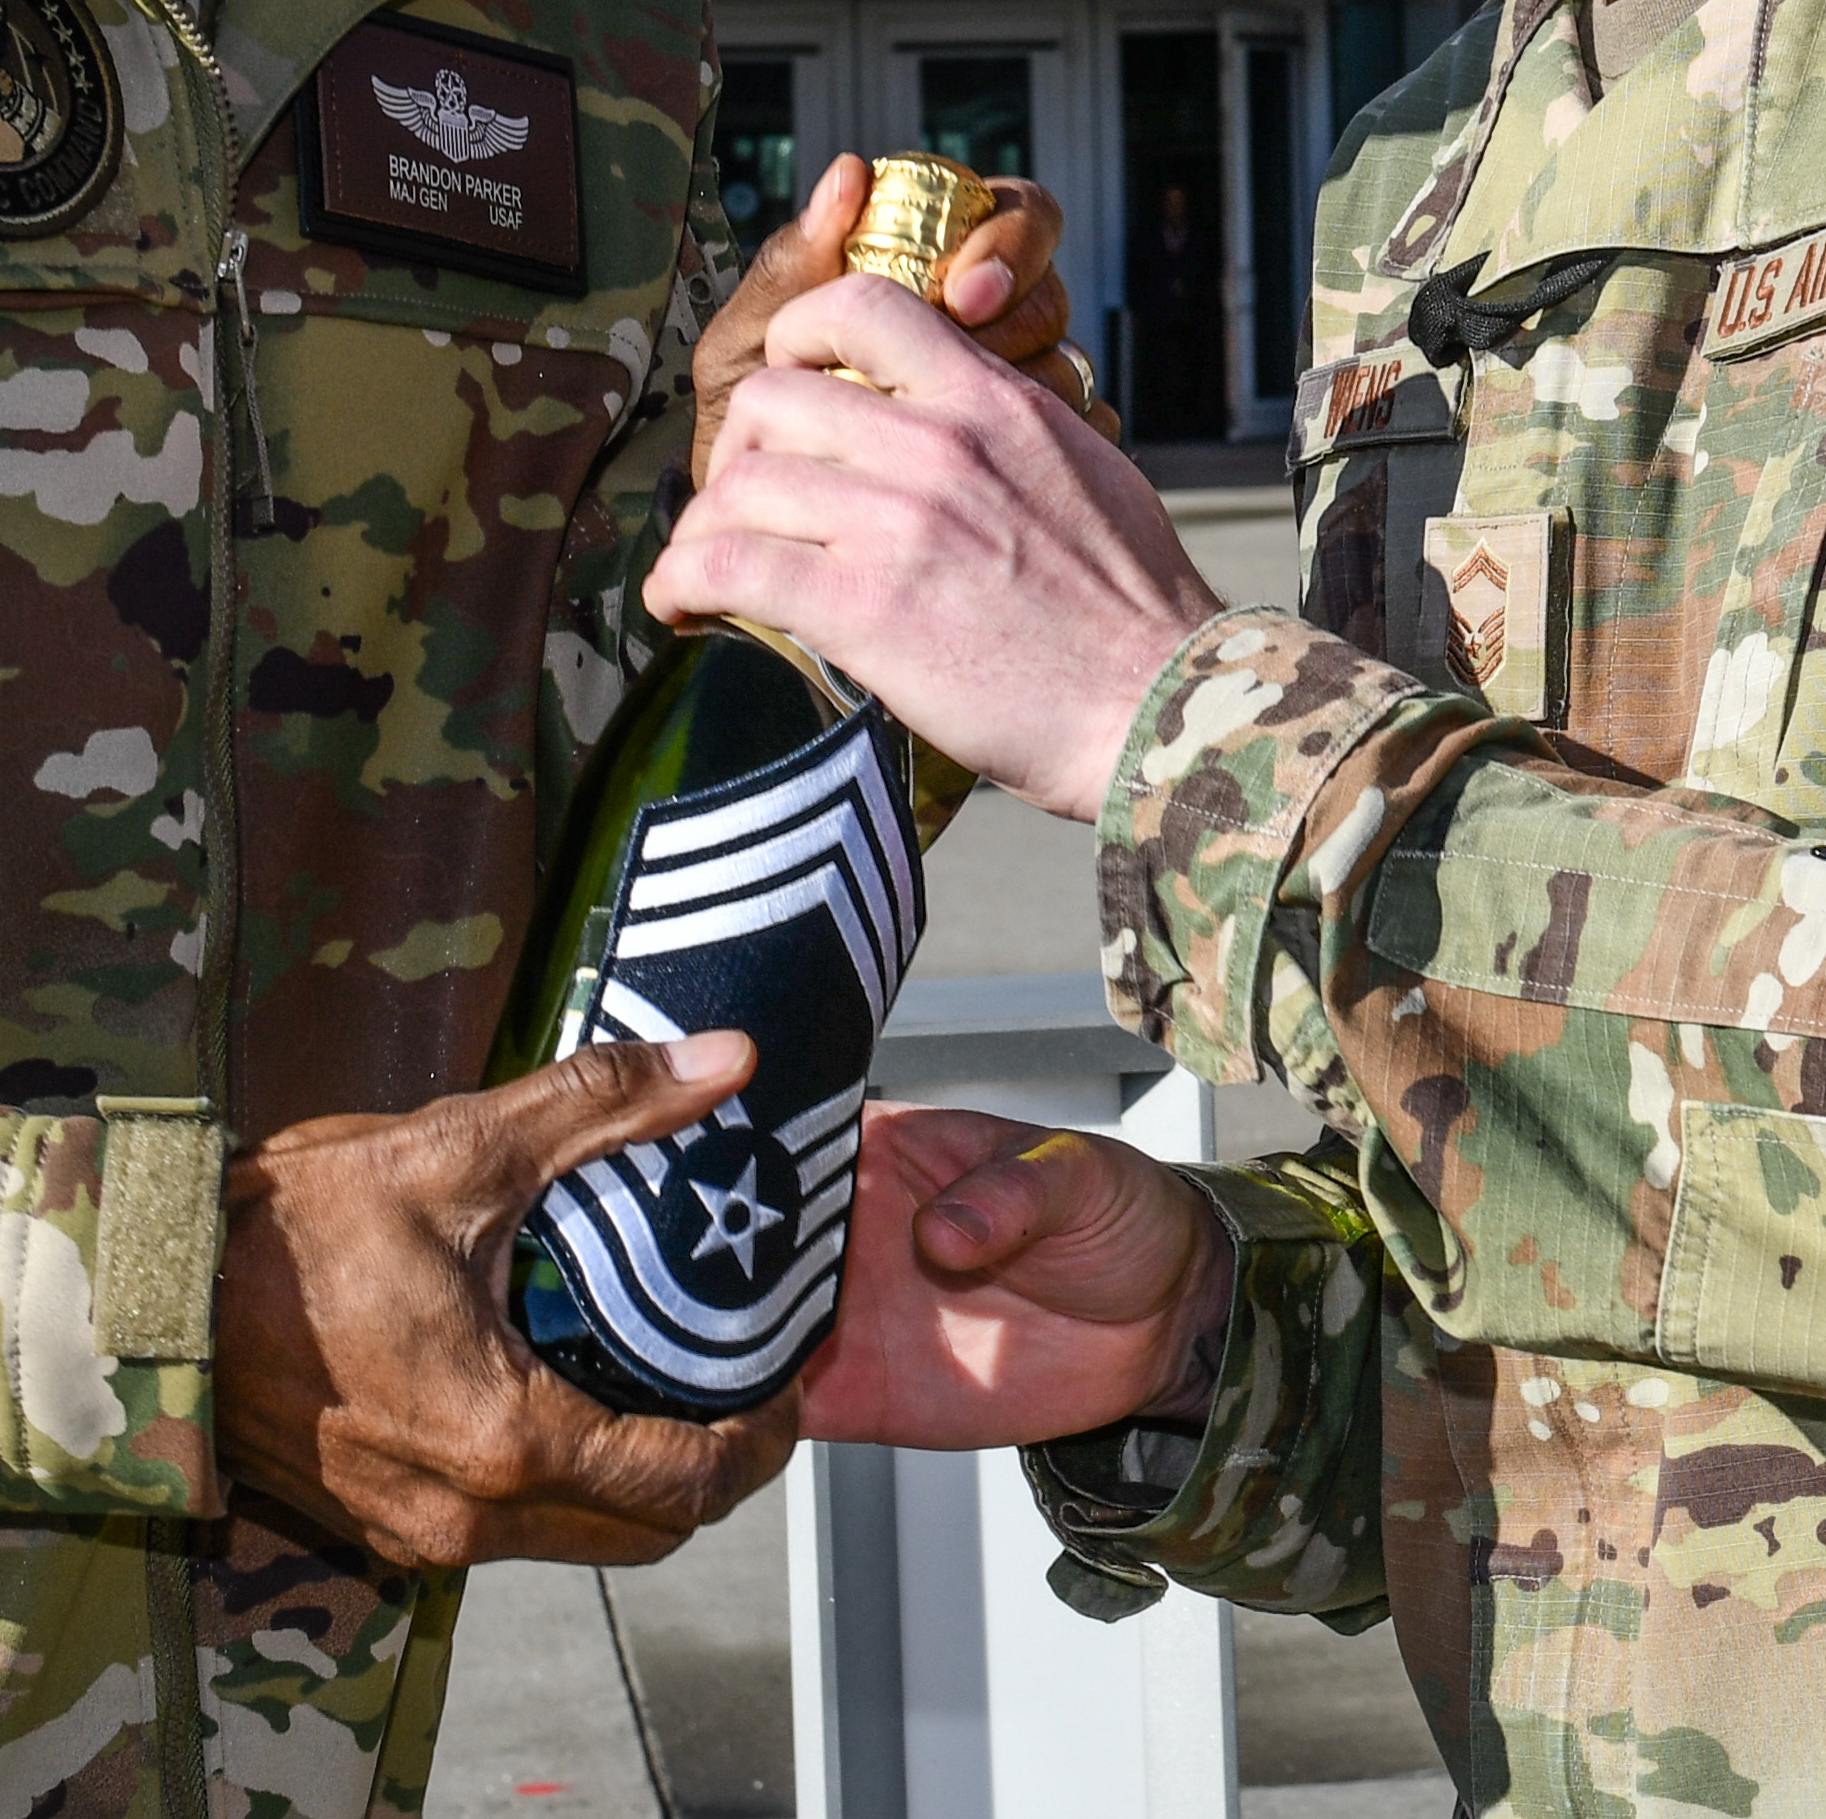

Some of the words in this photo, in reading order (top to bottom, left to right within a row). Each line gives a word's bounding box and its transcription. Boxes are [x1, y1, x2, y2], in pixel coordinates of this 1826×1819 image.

[19, 98, 104, 208] COMMAND
[389, 154, 462, 193] BRANDON
[465, 176, 522, 209] PARKER
[389, 180, 417, 204] MAJ
[420, 189, 448, 212] GEN
[489, 205, 523, 230] USAF
